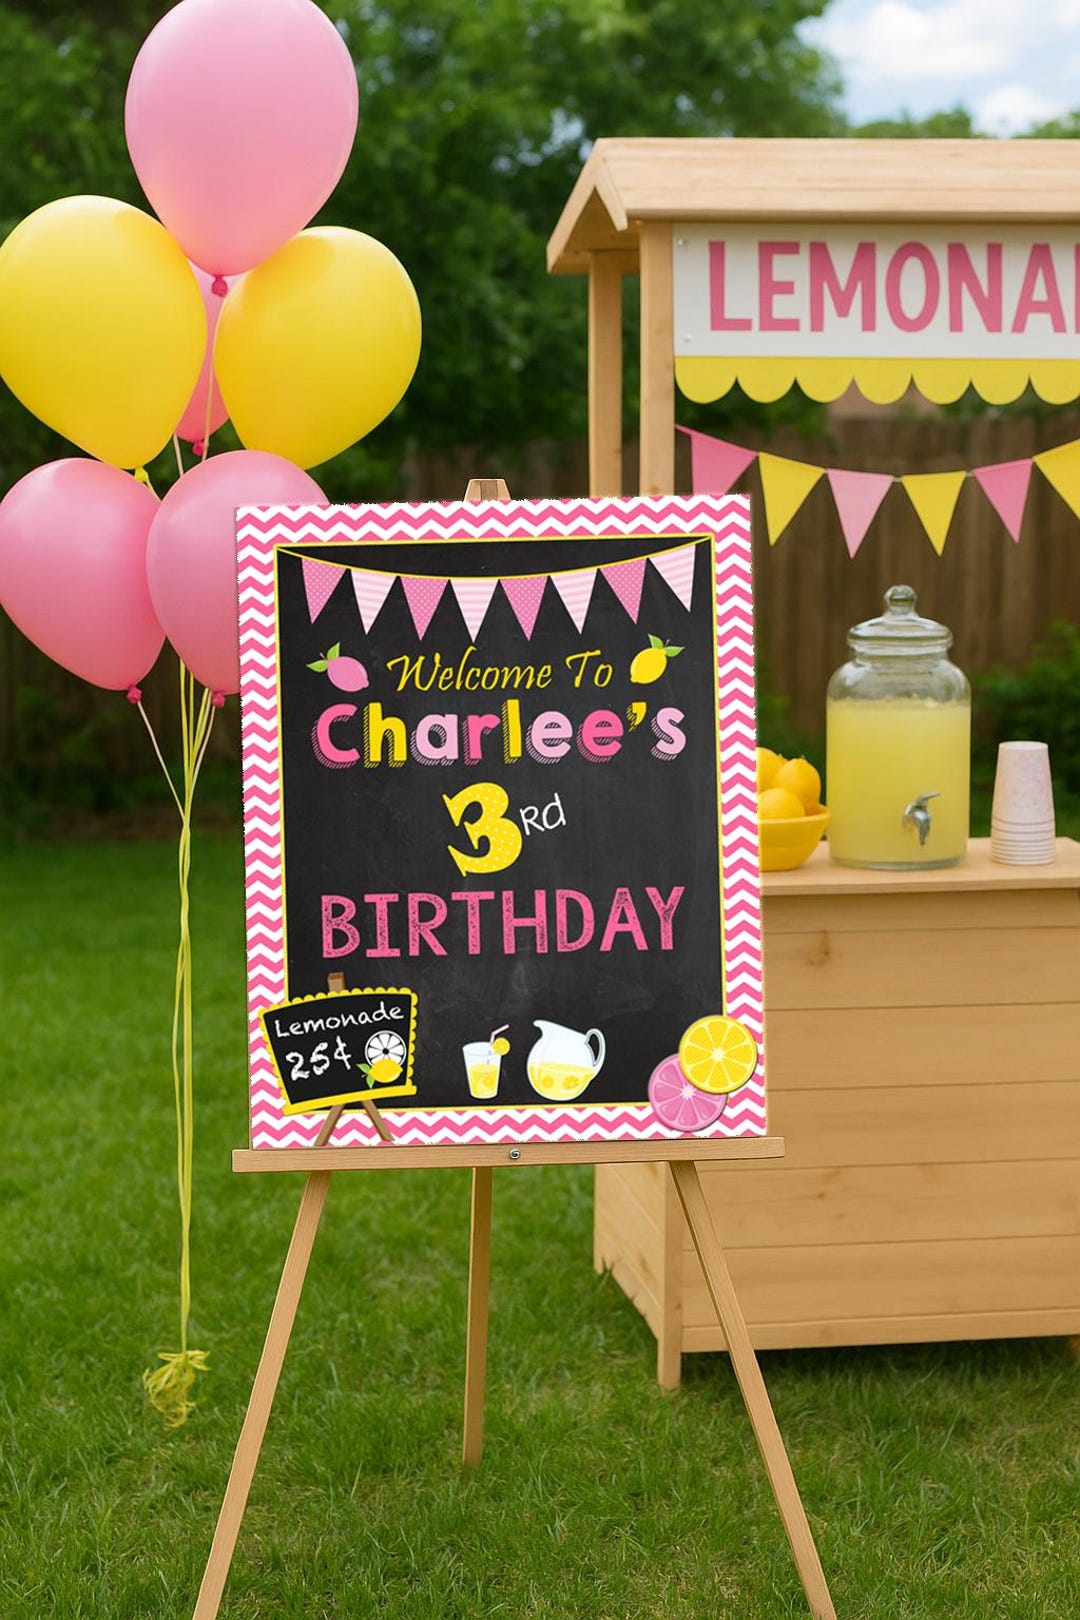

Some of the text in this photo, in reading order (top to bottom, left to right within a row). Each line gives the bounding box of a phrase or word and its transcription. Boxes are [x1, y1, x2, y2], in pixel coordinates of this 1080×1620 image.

[708, 240, 1080, 334] LEMONA
[387, 645, 613, 692] Welcome To
[320, 885, 686, 959] BIRTHDAY
[274, 1000, 405, 1038] Lemonade
[285, 1035, 353, 1082] 25¢
